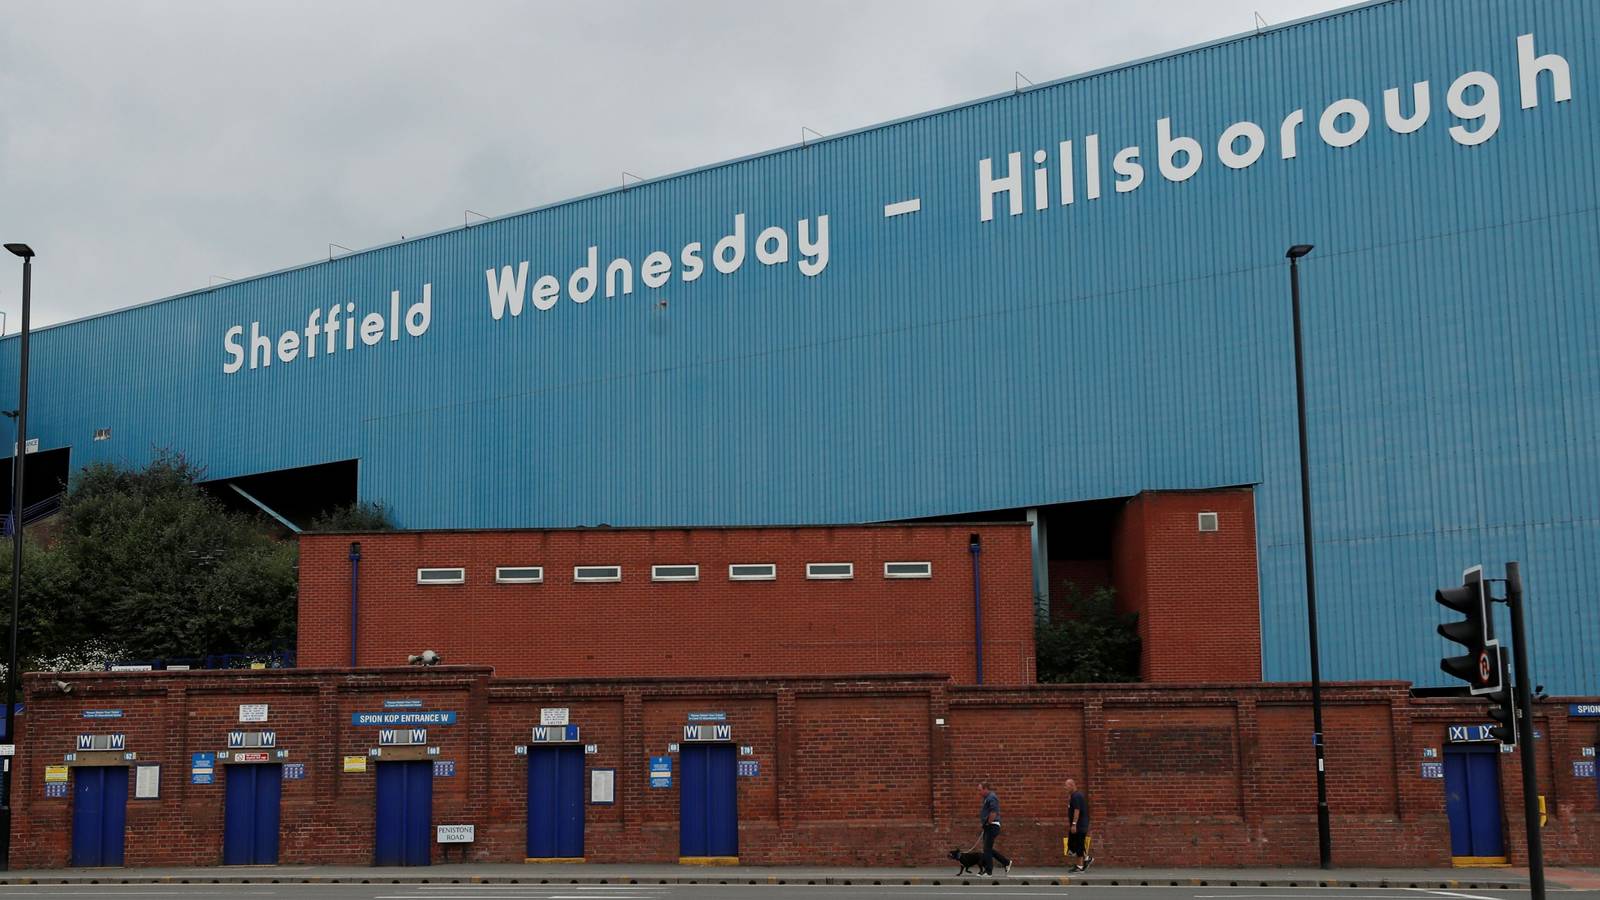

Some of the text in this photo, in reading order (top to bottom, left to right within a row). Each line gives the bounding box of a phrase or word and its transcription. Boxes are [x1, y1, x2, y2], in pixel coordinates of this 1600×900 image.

[222, 282, 433, 375] Sheffield
[485, 212, 831, 321] Wednesday
[978, 32, 1572, 223] Hillsborough
[360, 713, 449, 723] SPION KOP ENTRANCE W
[231, 732, 274, 744] W W
[382, 729, 425, 742] W W
[535, 727, 547, 739] W
[686, 726, 729, 738] W W
[1452, 726, 1463, 739] X
[80, 734, 123, 747] W W
[438, 826, 473, 834] PENISTONE
